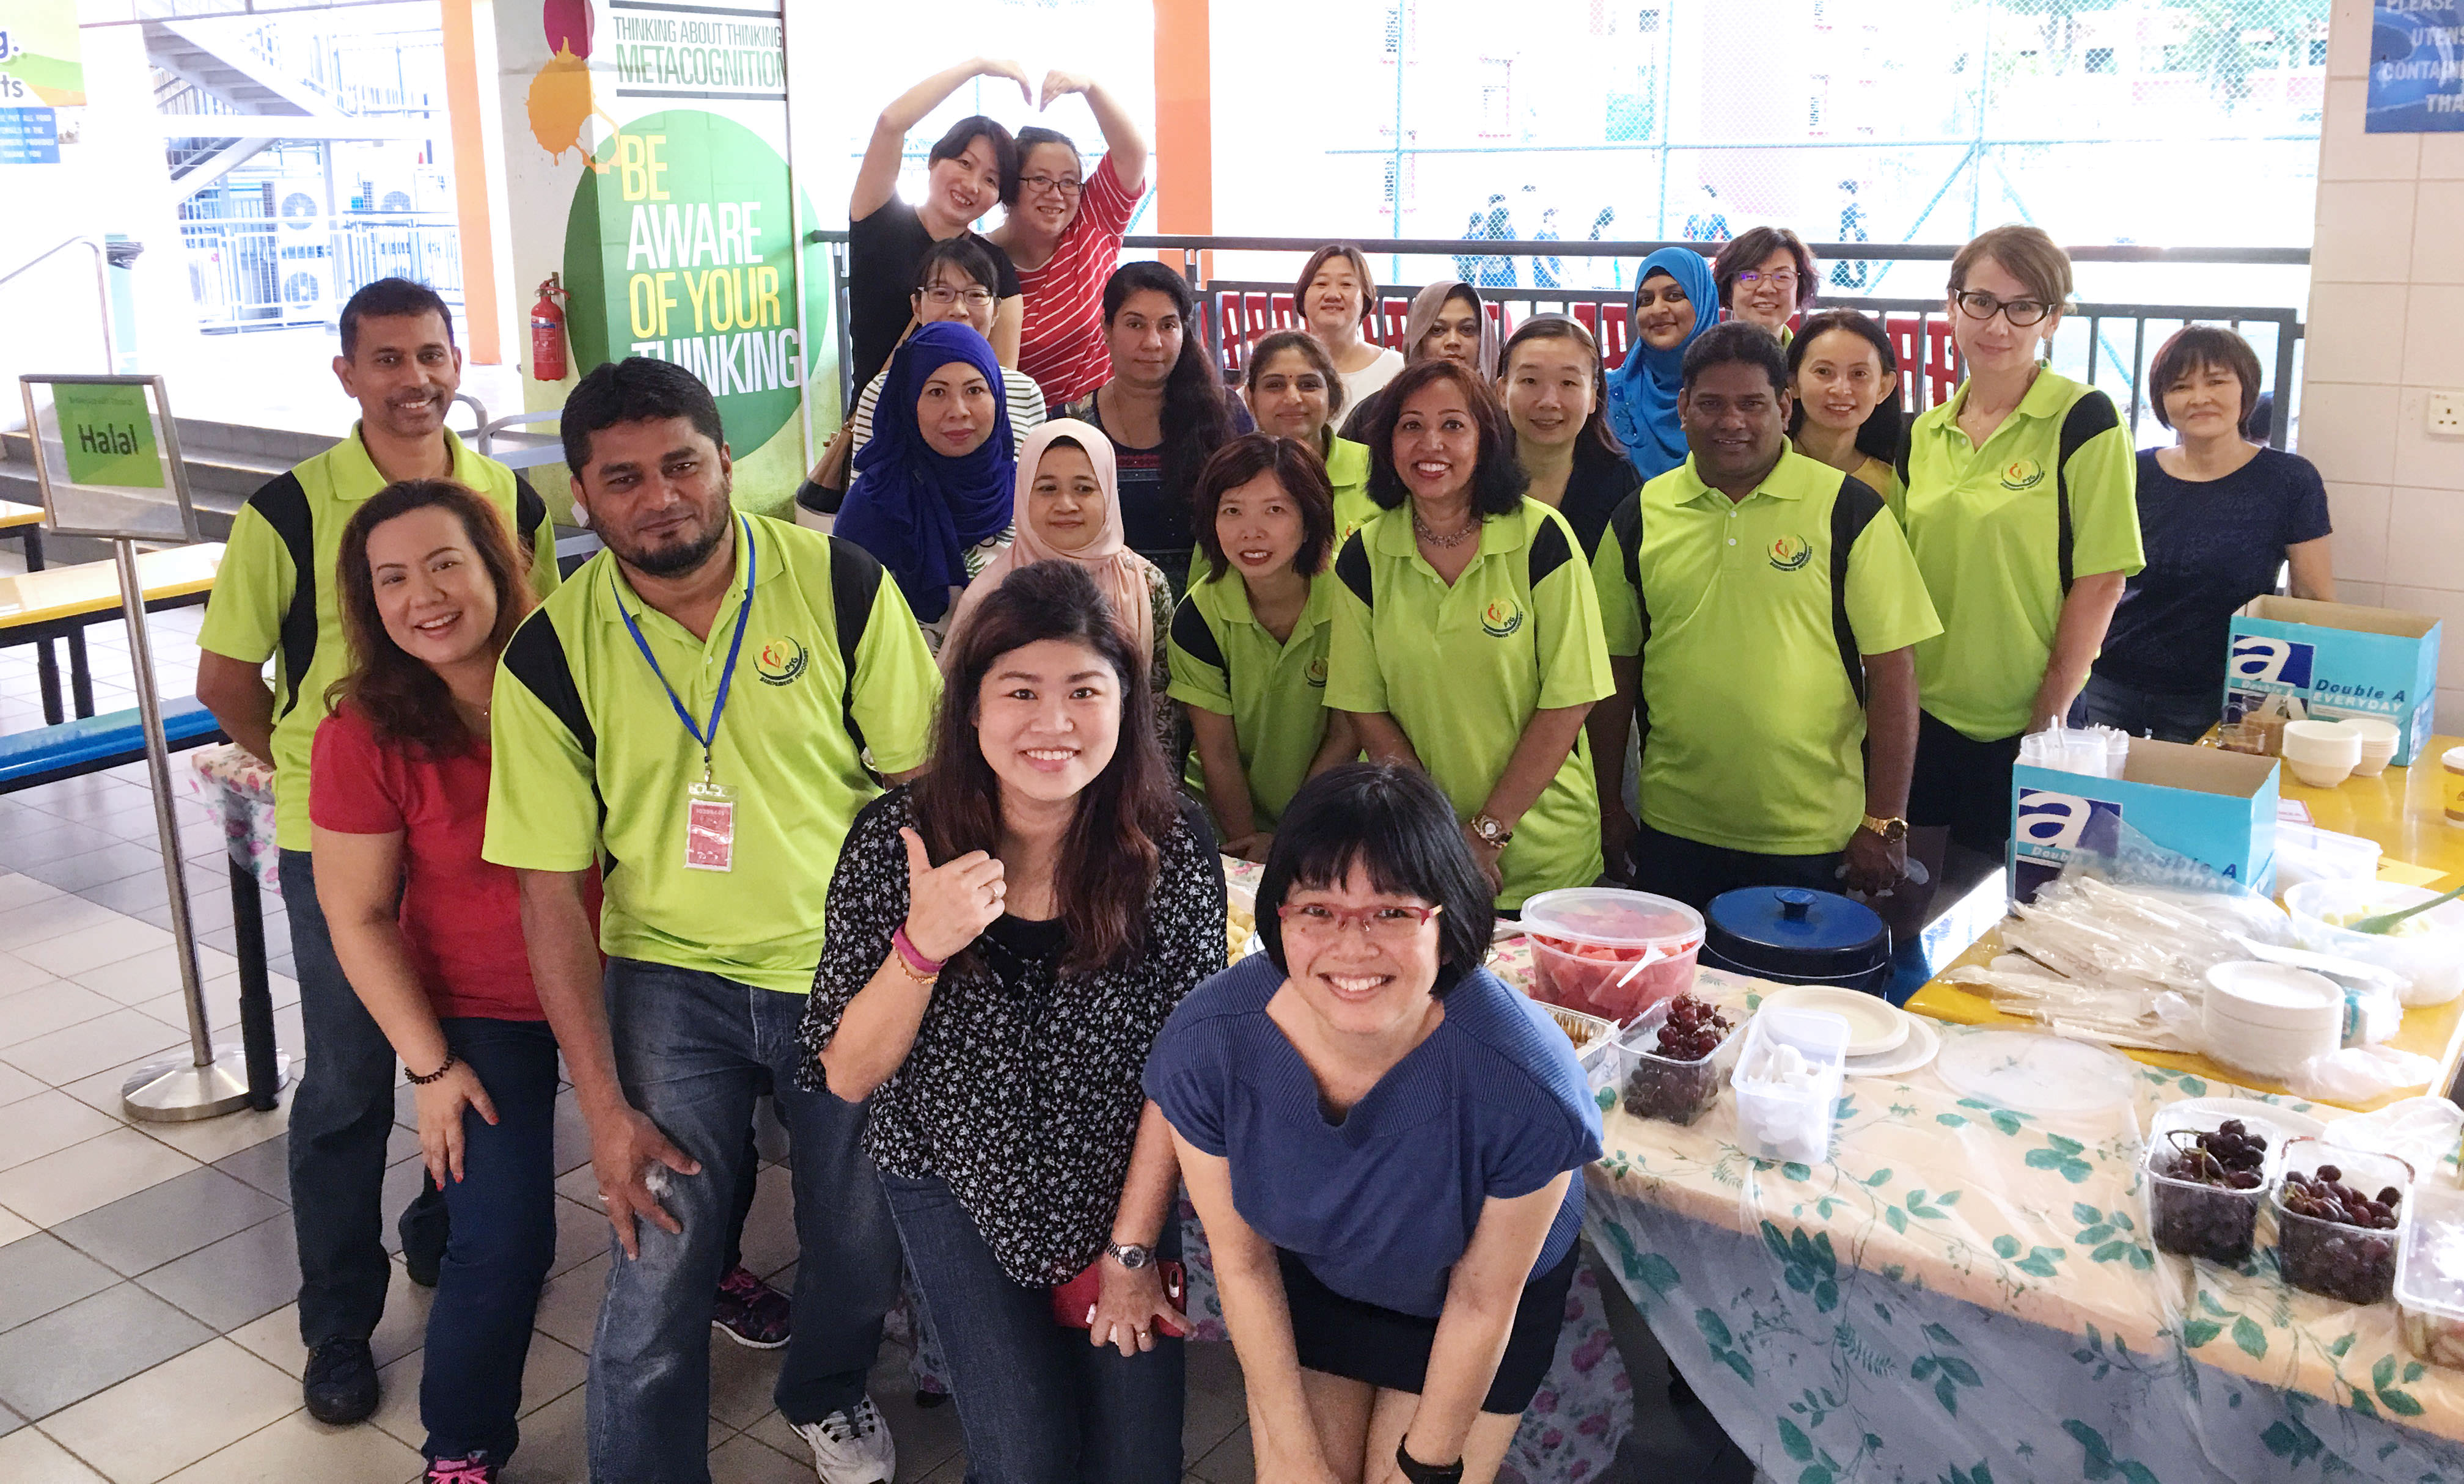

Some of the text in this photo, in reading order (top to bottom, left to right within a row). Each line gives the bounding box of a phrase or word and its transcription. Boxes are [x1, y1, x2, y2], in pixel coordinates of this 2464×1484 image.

[613, 16, 782, 48] THINKING ABOUT THINKING
[616, 43, 787, 87] METACOGNITION
[620, 135, 670, 201] BE
[626, 202, 763, 271] AWARE
[629, 266, 781, 338] OF YOUR
[631, 328, 801, 397] INKING
[78, 423, 139, 455] Halal
[785, 657, 799, 673] PSG
[2313, 692, 2404, 712] EVERYDAY
[2316, 679, 2405, 702] Double A
[2223, 863, 2237, 879] A
